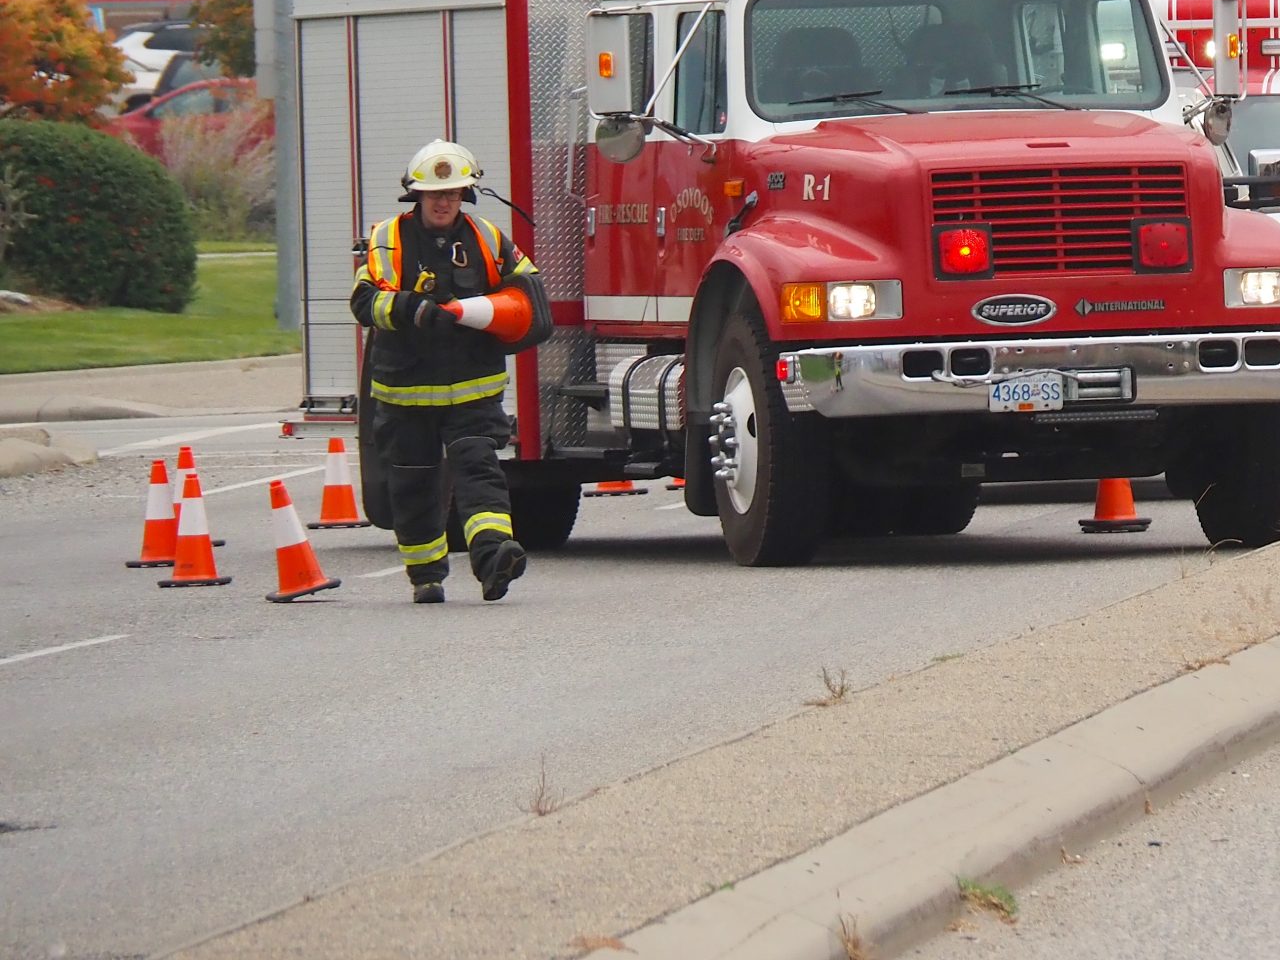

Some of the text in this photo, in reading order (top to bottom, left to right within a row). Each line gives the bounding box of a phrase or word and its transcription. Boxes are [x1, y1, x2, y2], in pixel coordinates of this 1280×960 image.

[803, 173, 831, 201] R-1
[670, 187, 714, 225] OSOYOOS
[981, 303, 1047, 317] SUPERIOR
[1094, 299, 1166, 312] INTERNATIONAL
[993, 383, 1030, 402] 4368
[1041, 382, 1060, 401] SS
